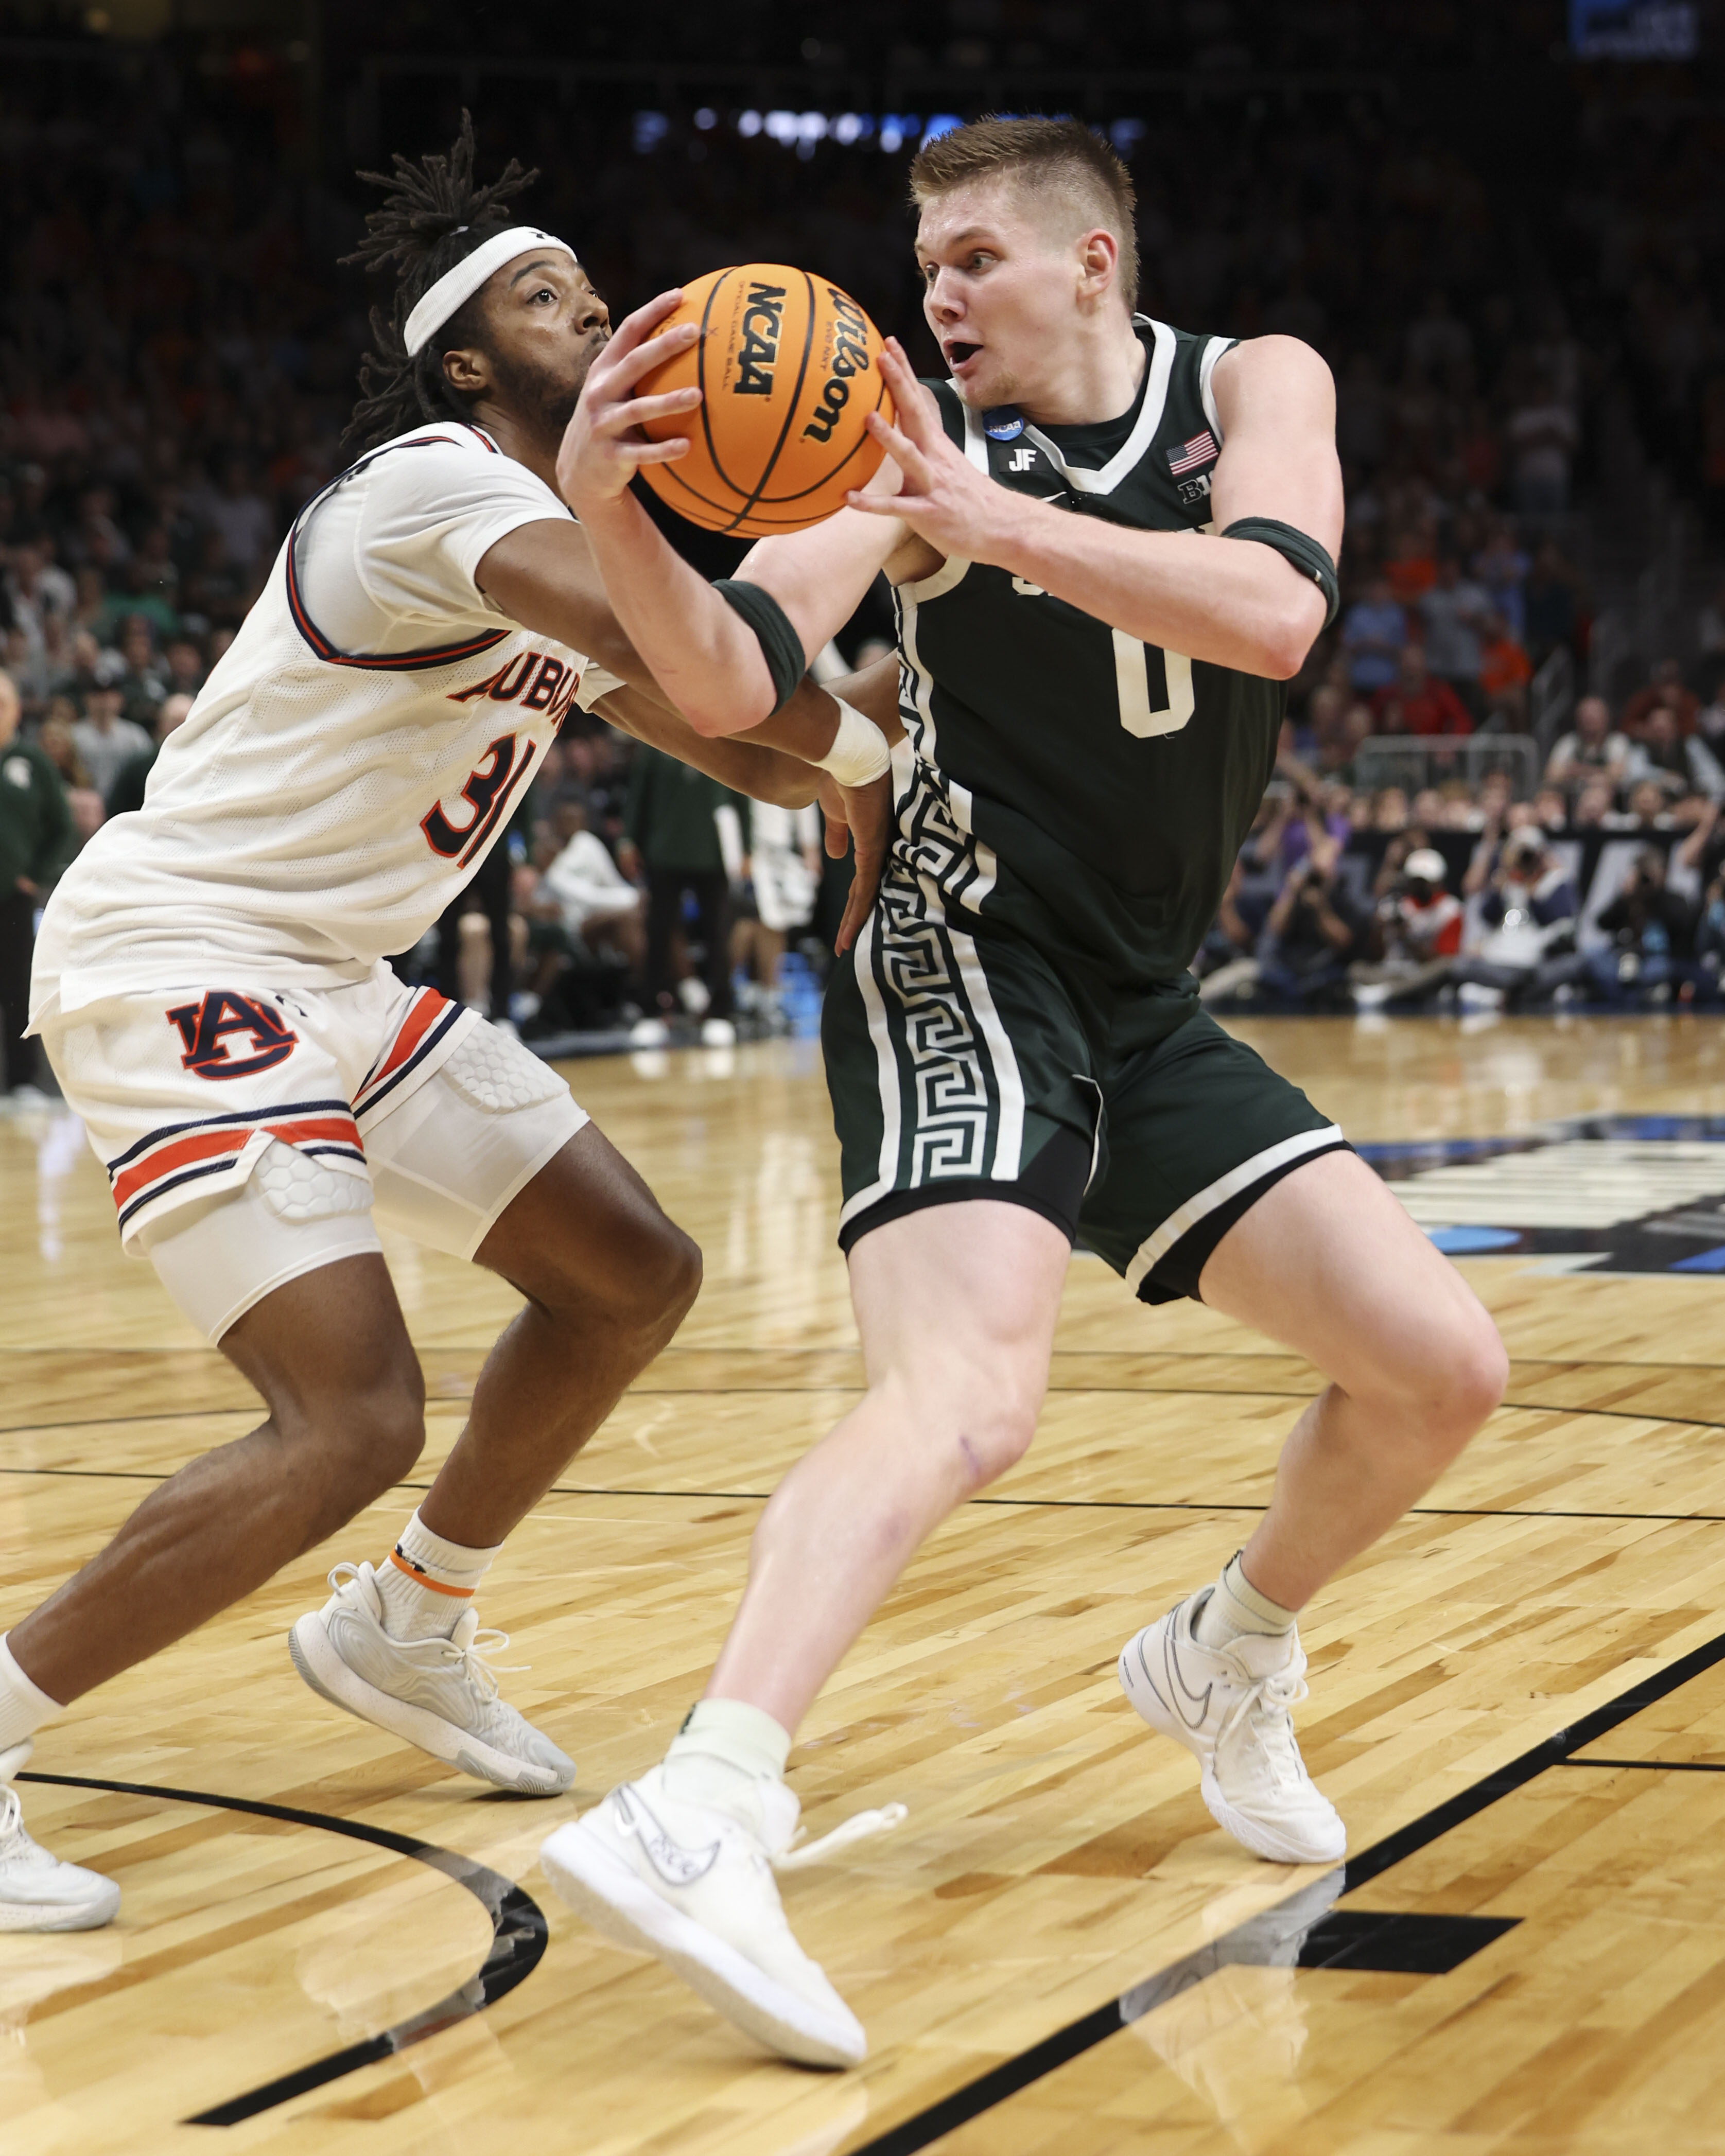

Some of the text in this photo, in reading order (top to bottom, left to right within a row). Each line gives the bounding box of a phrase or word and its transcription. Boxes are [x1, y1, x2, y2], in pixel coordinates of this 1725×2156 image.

[727, 320, 739, 354] GAME
[733, 282, 786, 395] NCAA
[803, 287, 868, 443] Wilson
[722, 357, 733, 391] BALL
[989, 420, 1022, 433] NCAA
[1008, 448, 1037, 471] JF
[1111, 627, 1195, 739] 0
[420, 732, 537, 871] 31
